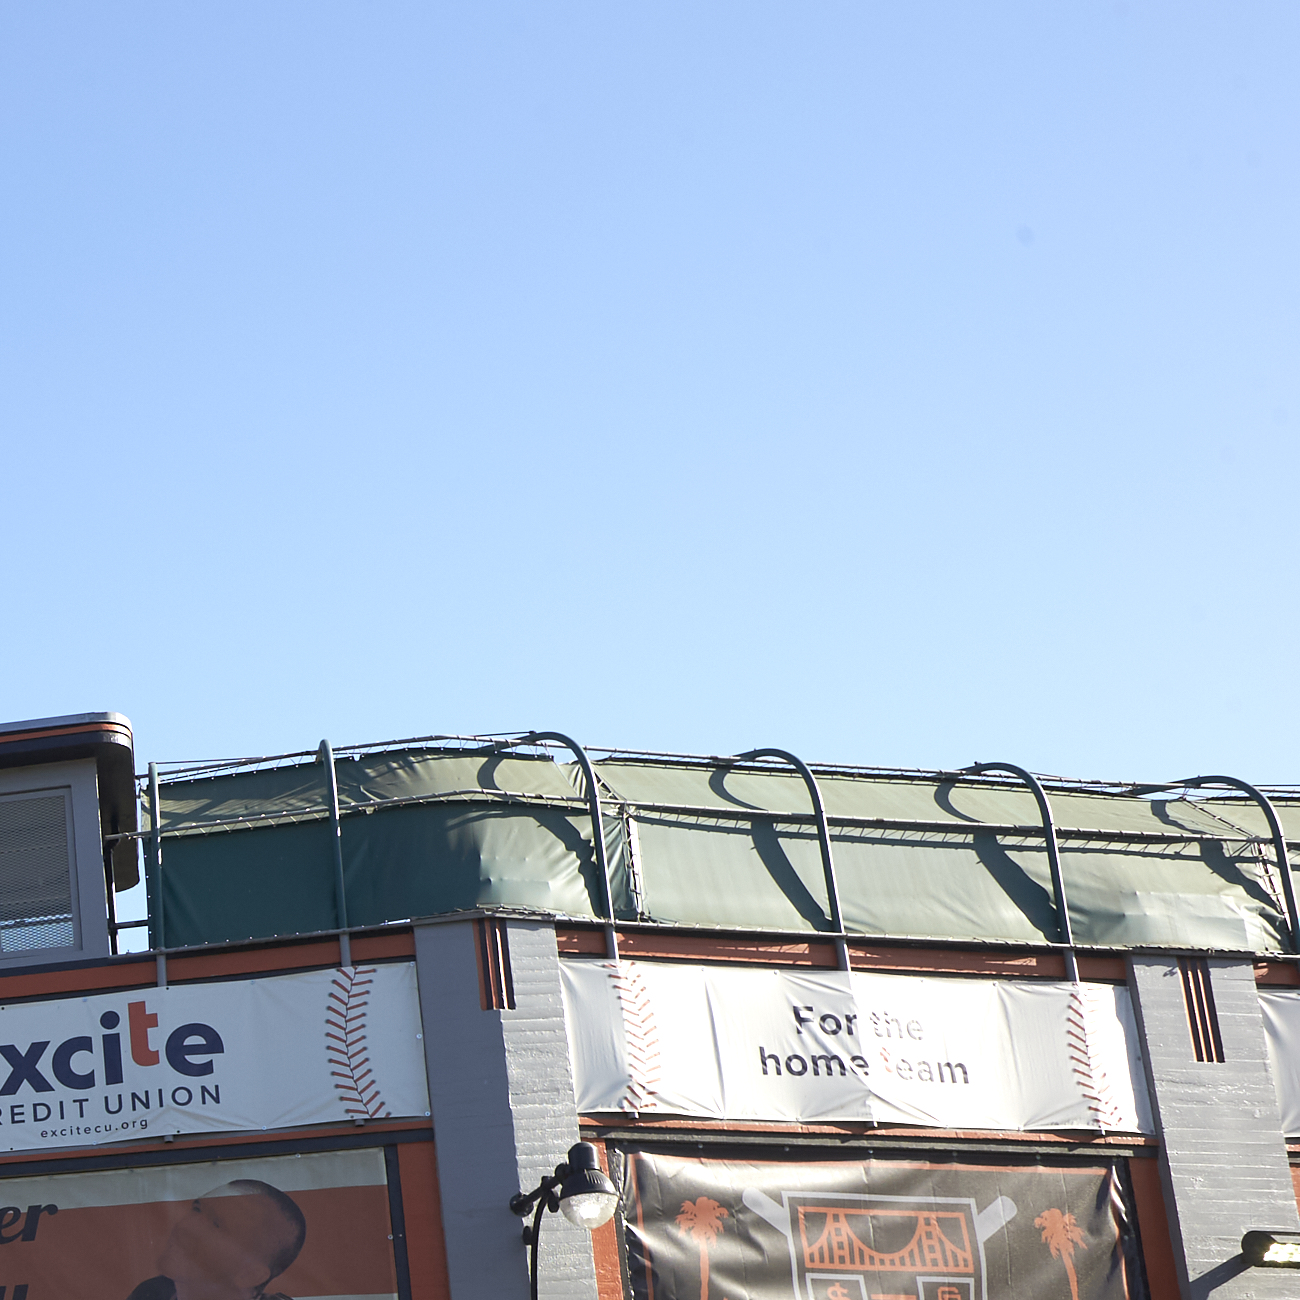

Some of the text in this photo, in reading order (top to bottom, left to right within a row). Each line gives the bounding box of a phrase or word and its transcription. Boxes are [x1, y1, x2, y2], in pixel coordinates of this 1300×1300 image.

[793, 1006, 857, 1036] For
[759, 1046, 870, 1077] home
[103, 1084, 221, 1115] UNION
[40, 1116, 150, 1139] excitecu.org
